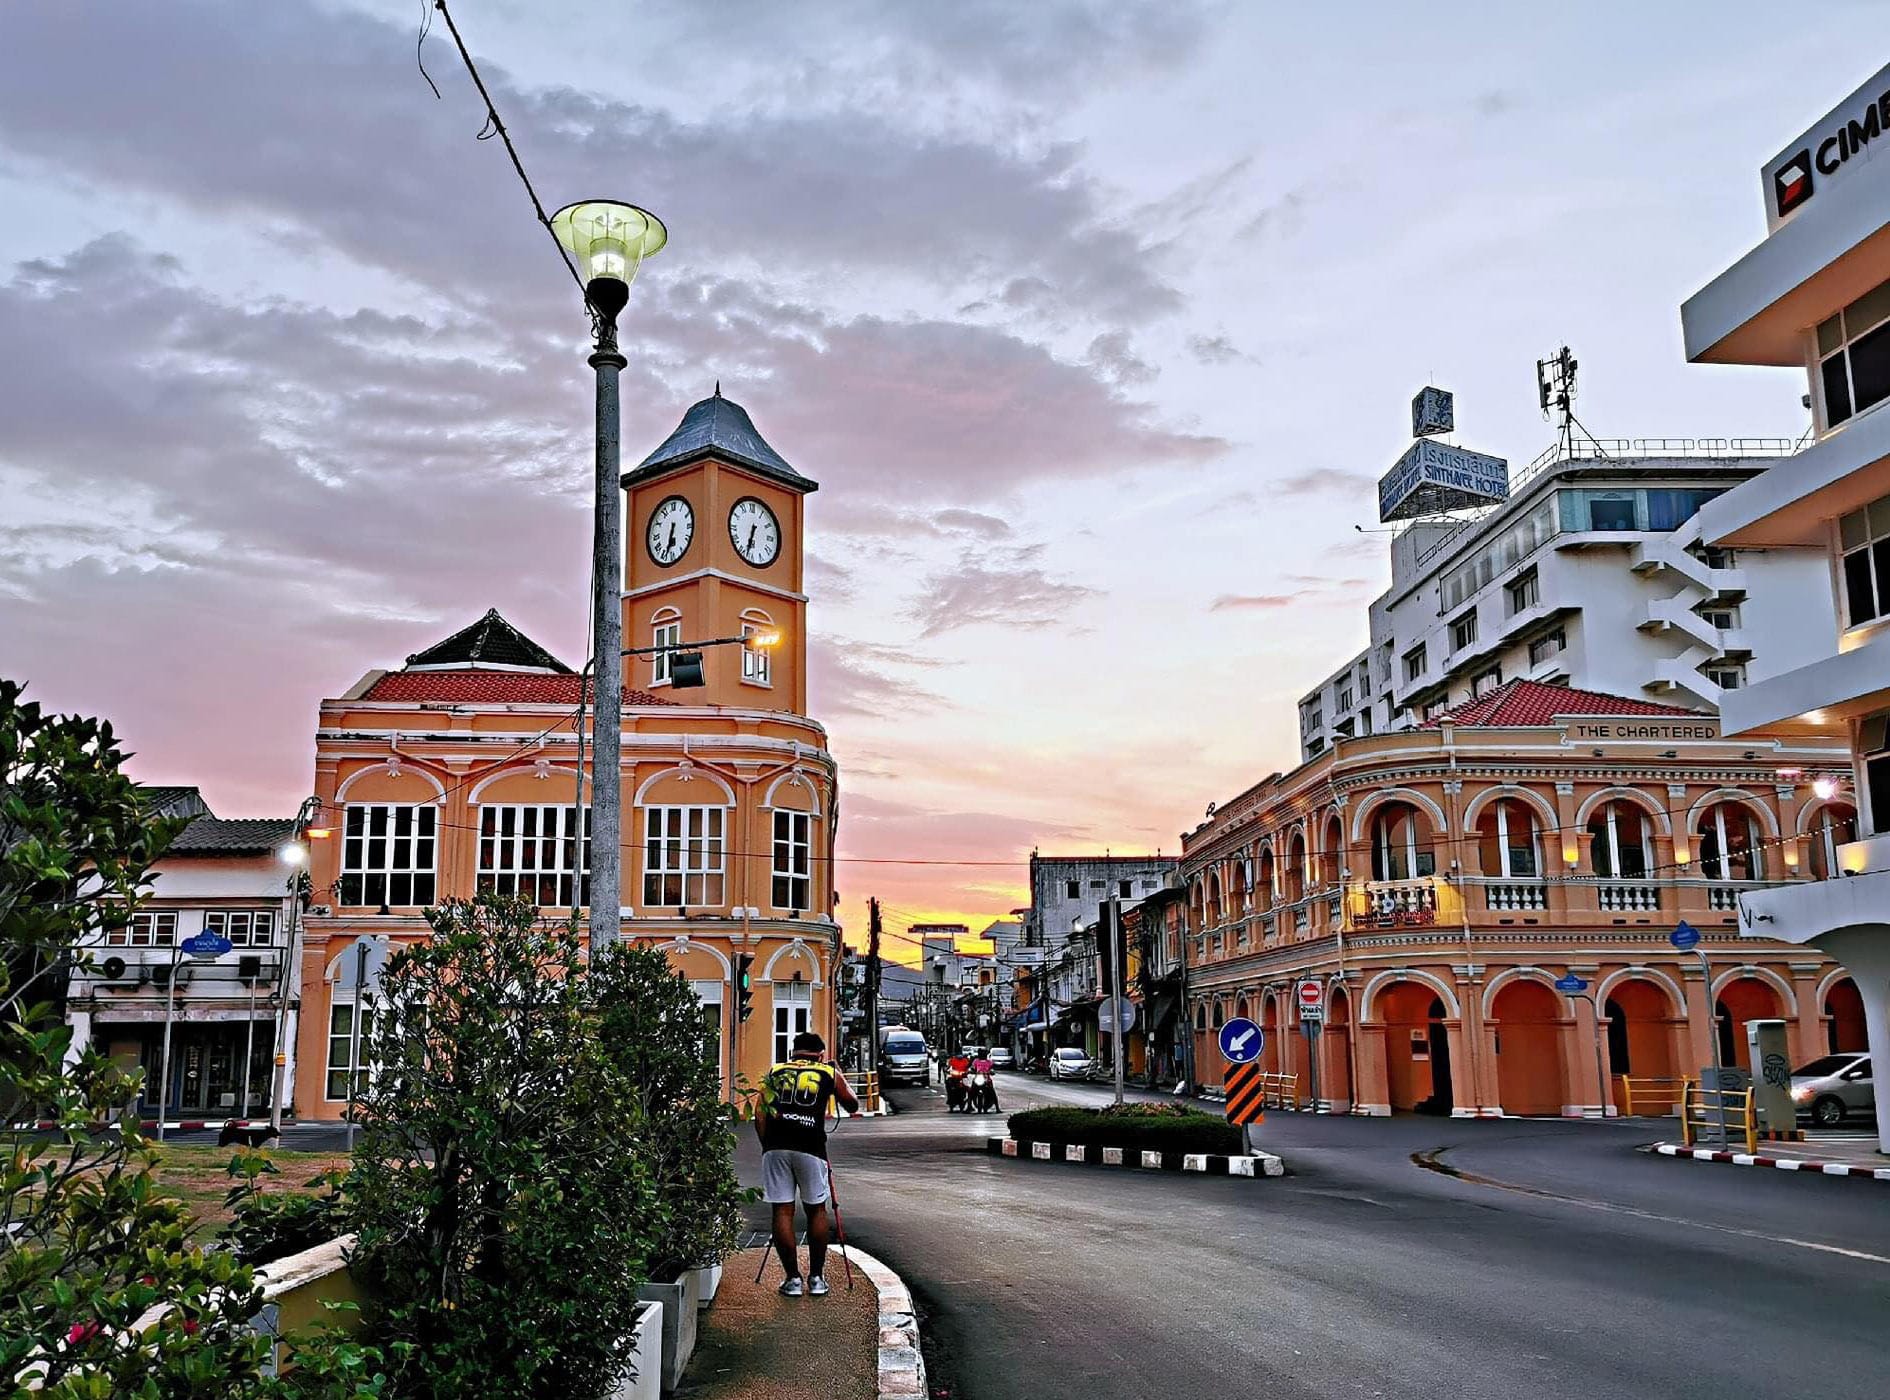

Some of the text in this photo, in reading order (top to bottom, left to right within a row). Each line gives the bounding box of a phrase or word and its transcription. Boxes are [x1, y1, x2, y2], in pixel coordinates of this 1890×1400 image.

[1475, 476, 1509, 497] HOTEL
[1577, 725, 1715, 738] THE CHARTERED
